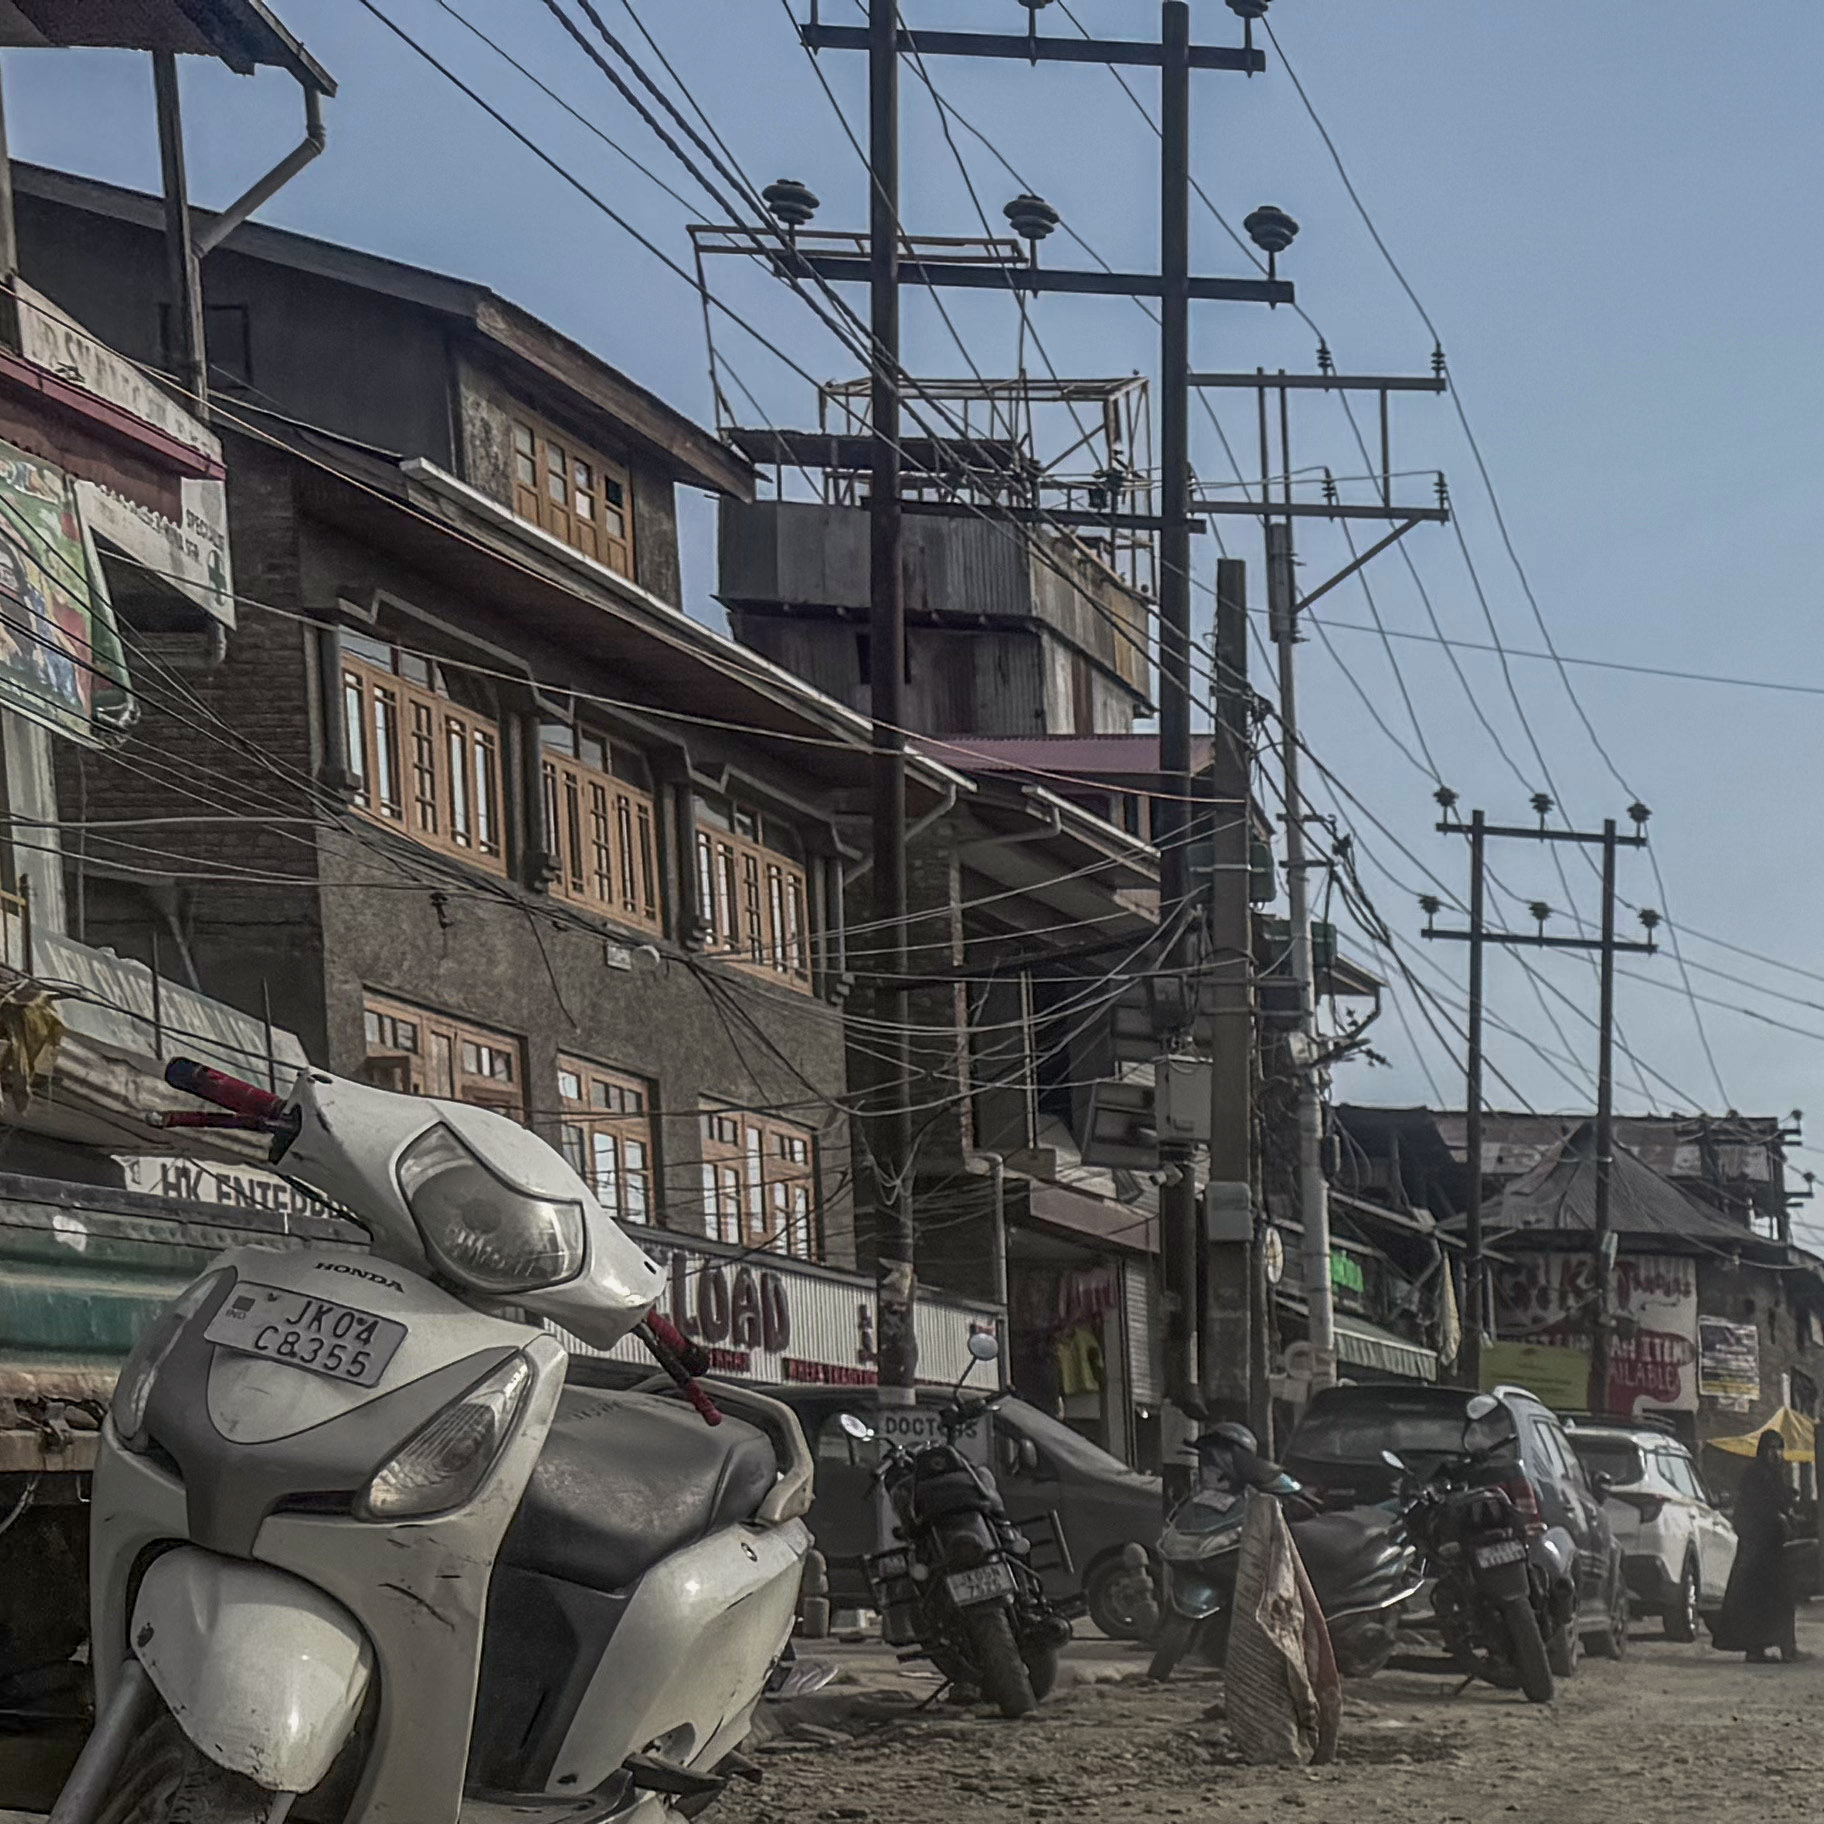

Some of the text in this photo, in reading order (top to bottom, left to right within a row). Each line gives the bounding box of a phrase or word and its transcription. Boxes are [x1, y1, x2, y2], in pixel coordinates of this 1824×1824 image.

[314, 1261, 405, 1294] HONDA
[285, 1299, 380, 1346] JK04
[254, 1325, 372, 1378] C8355
